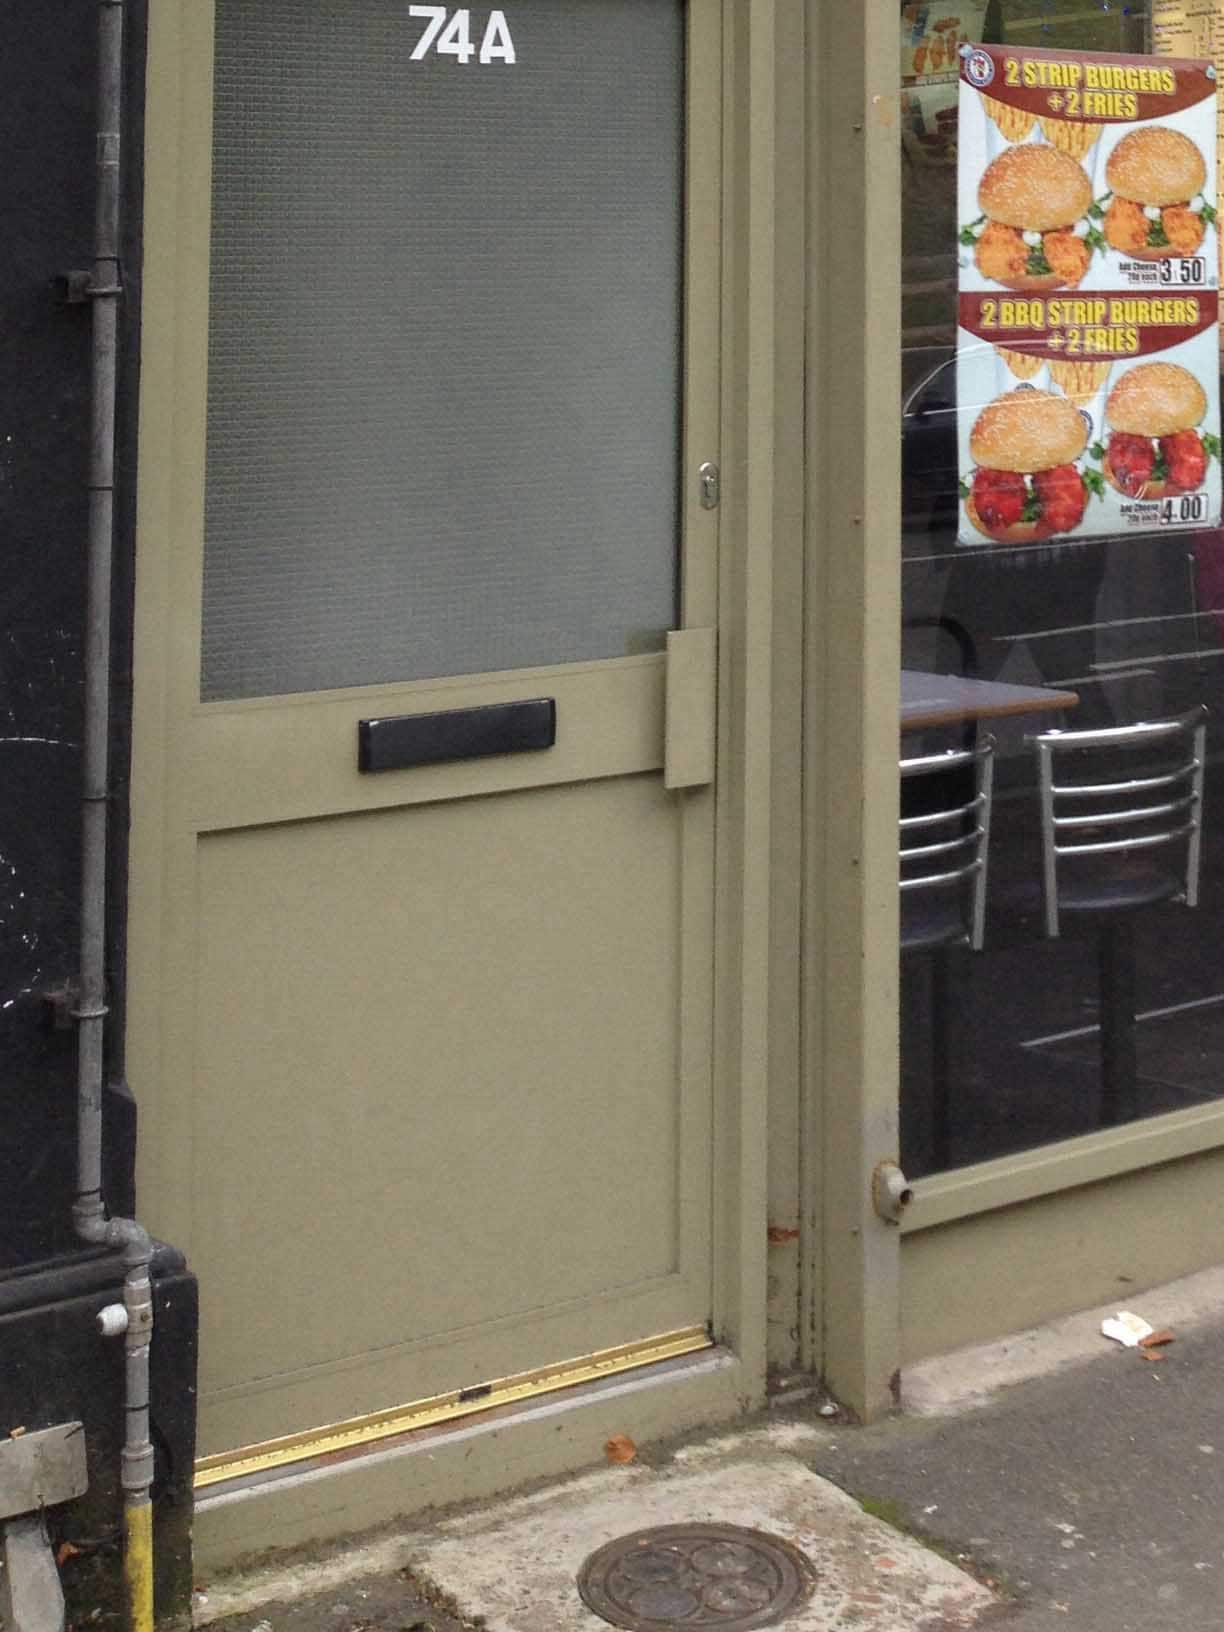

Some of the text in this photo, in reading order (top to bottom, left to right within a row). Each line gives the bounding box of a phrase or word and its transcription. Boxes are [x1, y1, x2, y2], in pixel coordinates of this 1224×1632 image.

[408, 4, 516, 64] 74A
[1005, 59, 1020, 86] 2
[1024, 60, 1081, 88] STRIP
[1086, 63, 1176, 93] BURGERS
[1066, 91, 1081, 116] 2
[1083, 92, 1138, 117] FRIES
[982, 299, 1198, 328] 2 BBQ STRIP BURGERS
[1066, 329, 1081, 353] 2
[1084, 328, 1138, 353] FRIES
